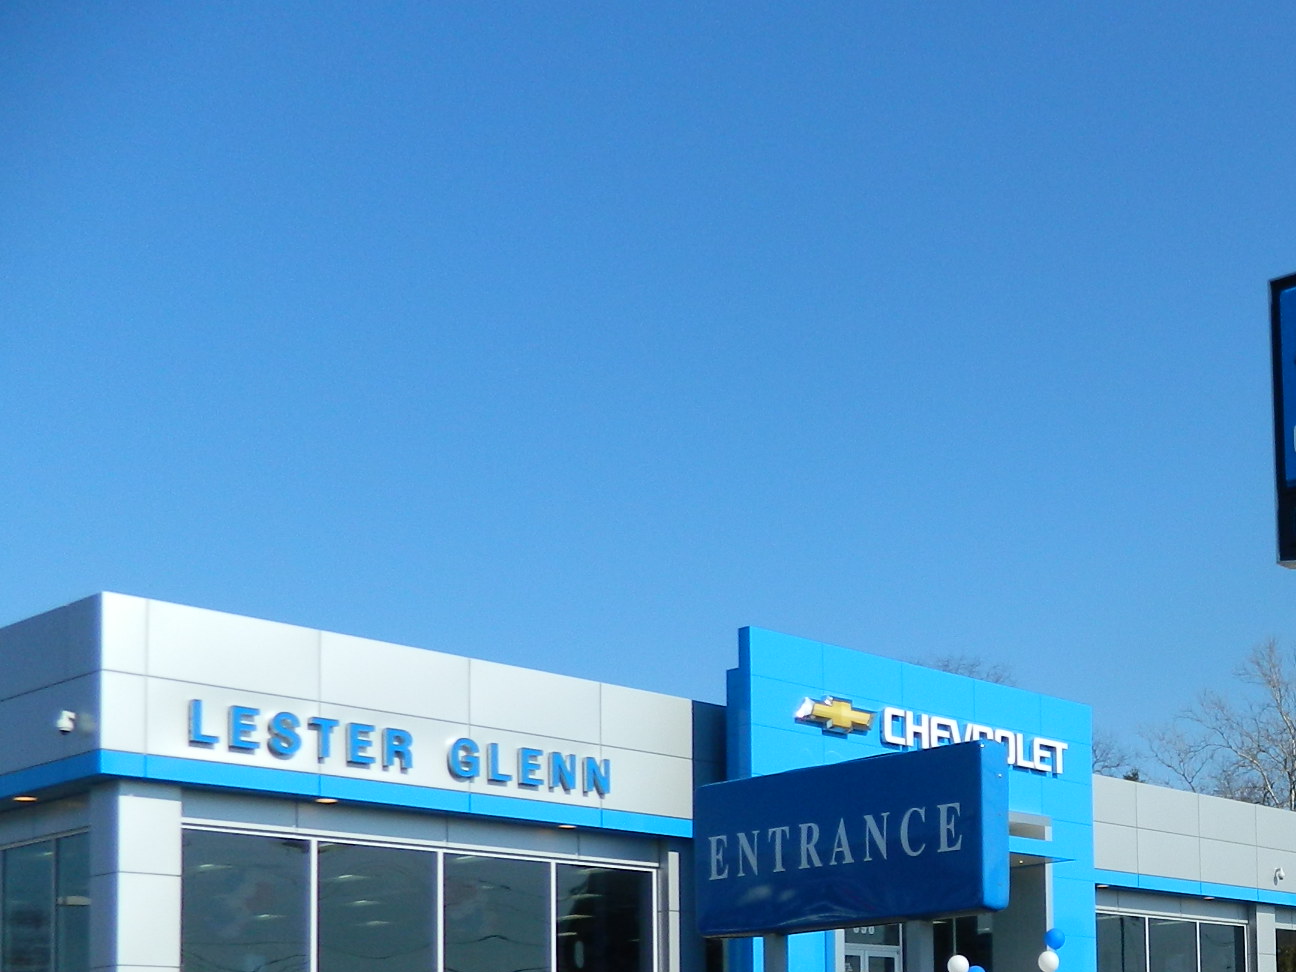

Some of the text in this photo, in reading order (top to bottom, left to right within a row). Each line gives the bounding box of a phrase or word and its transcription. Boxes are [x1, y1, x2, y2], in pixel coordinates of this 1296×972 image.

[188, 698, 611, 799] LESTER GLENN
[708, 802, 963, 881] ENTRANCE
